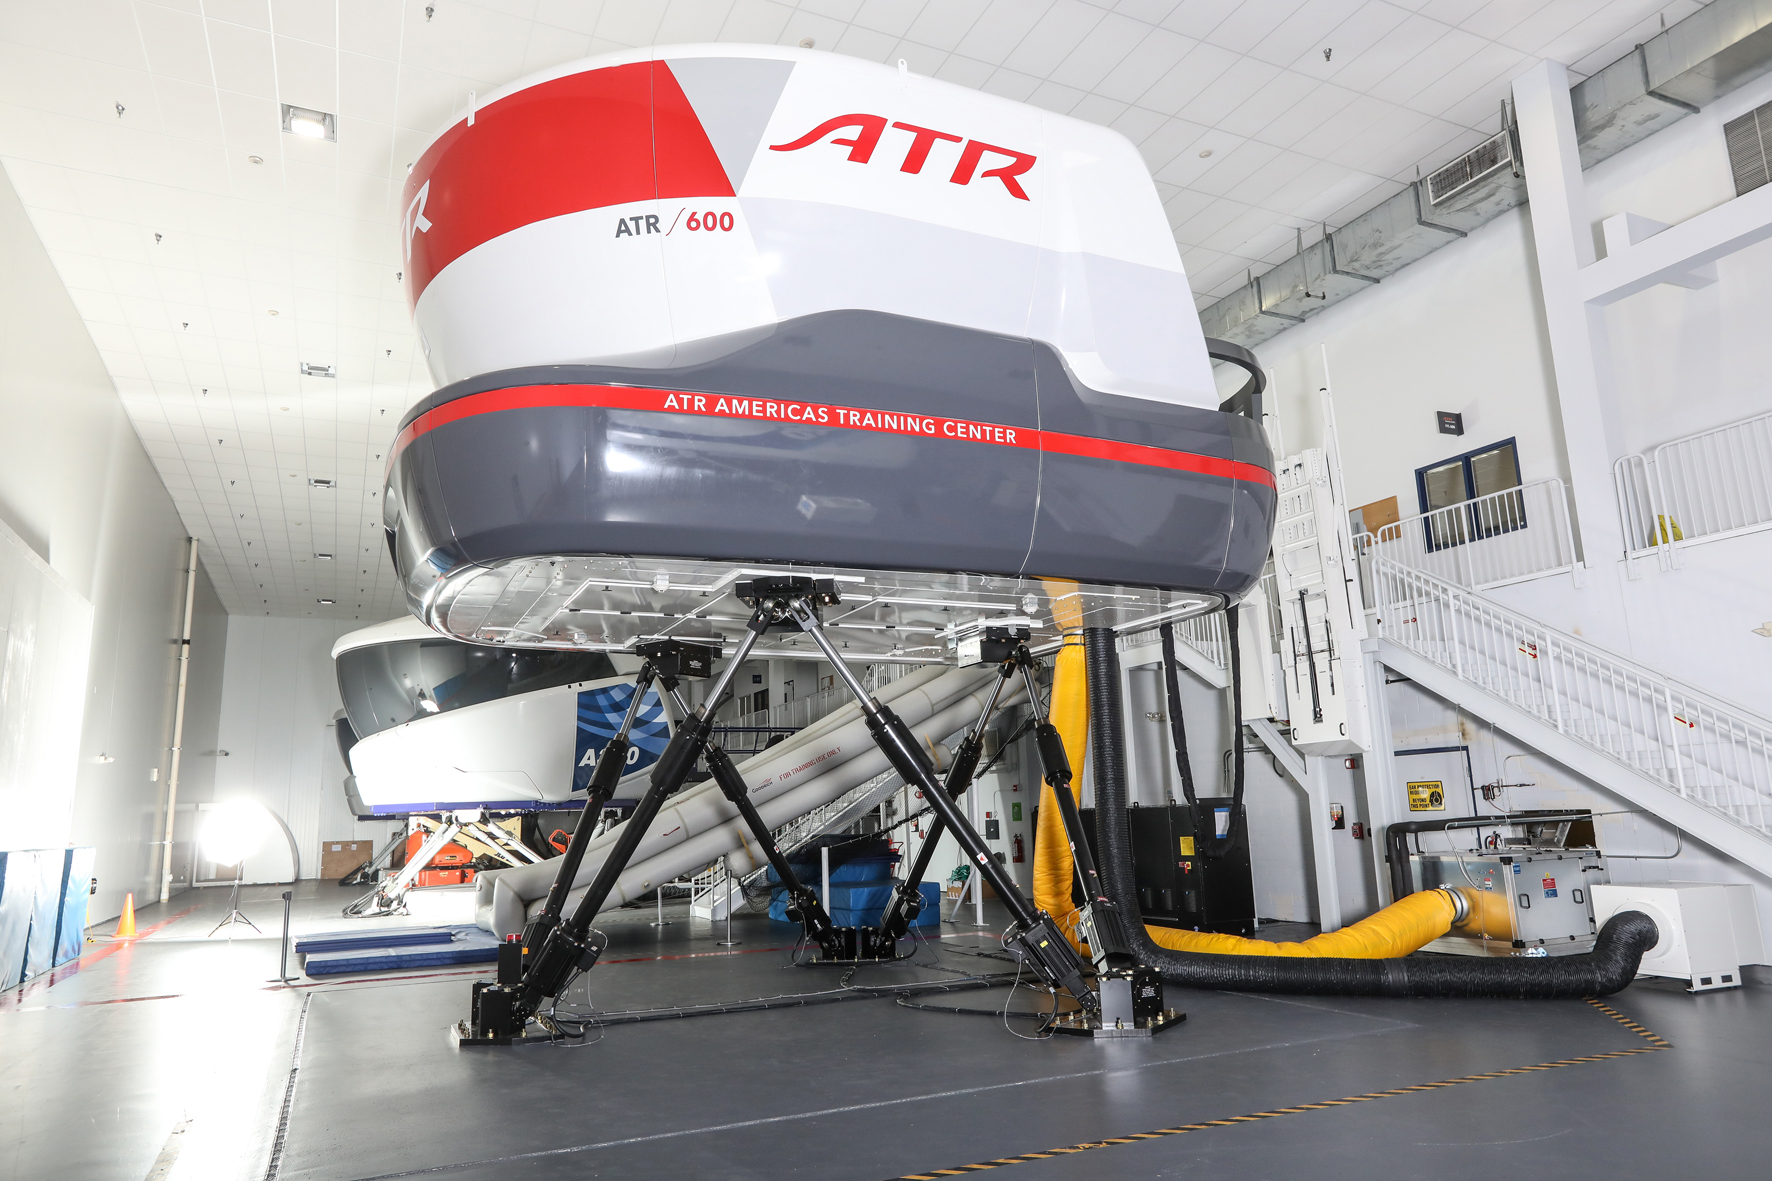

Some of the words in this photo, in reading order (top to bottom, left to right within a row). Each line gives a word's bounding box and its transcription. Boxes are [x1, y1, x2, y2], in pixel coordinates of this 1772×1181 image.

[769, 113, 1037, 202] ATR
[615, 214, 661, 238] ATR
[664, 393, 706, 411] ATR
[714, 398, 828, 423] AMERICAS
[836, 409, 935, 434] TRAINING
[943, 421, 1016, 444] CENTER
[578, 746, 640, 767] A0
[779, 771, 792, 781] FOR
[791, 759, 816, 775] TRAINING
[815, 753, 828, 763] USE
[827, 746, 842, 758] ONLY
